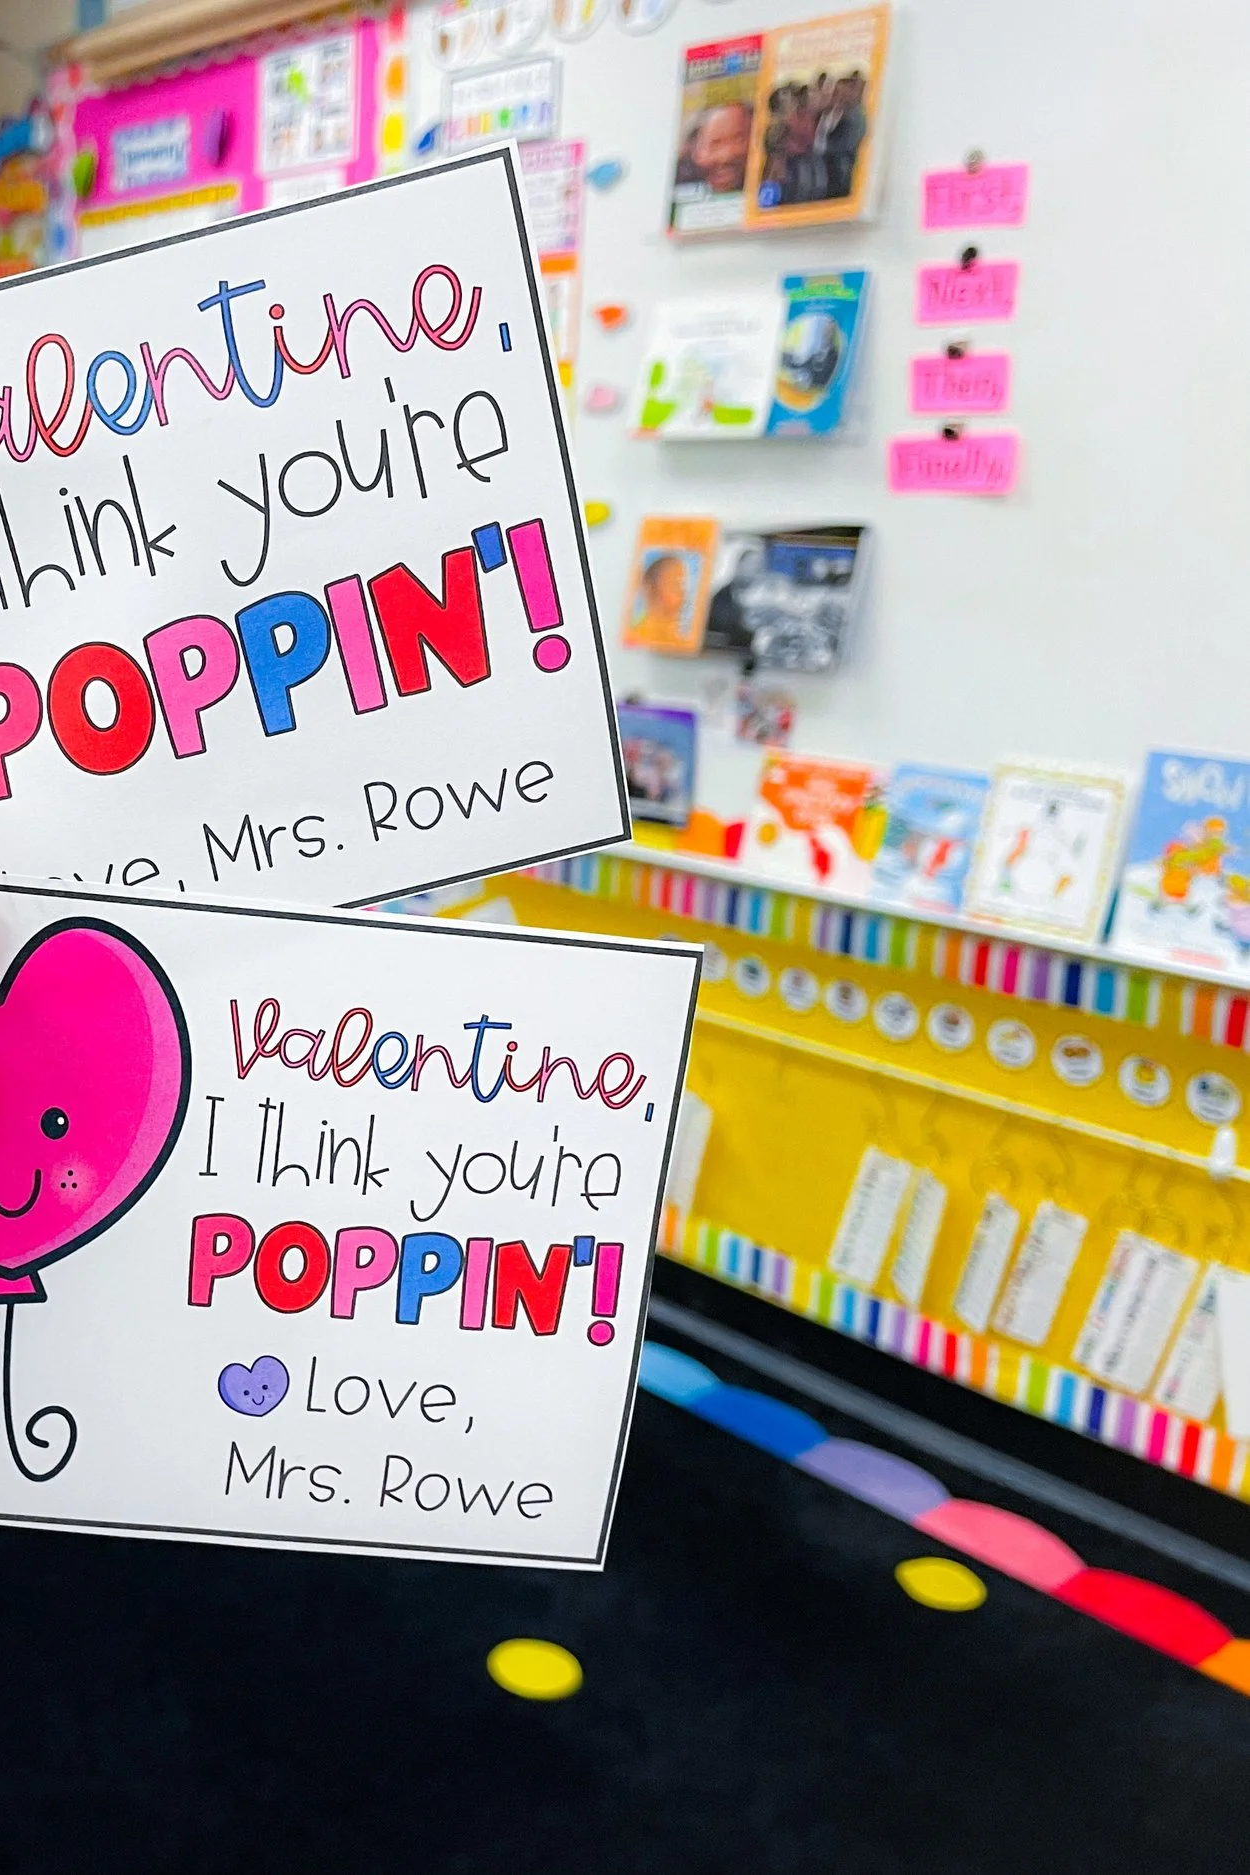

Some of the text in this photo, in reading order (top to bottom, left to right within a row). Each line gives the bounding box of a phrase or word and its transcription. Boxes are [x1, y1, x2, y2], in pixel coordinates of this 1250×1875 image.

[217, 376, 510, 586] you're
[202, 813, 345, 882] Mrs.
[363, 759, 554, 841] Rowe
[230, 997, 654, 1122] Valentine,
[198, 1095, 225, 1178] I
[410, 1124, 622, 1222] you're
[187, 1213, 625, 1347] POPPIN'!
[306, 1355, 475, 1435] Love,
[224, 1441, 554, 1520] Mrs. Rowe
